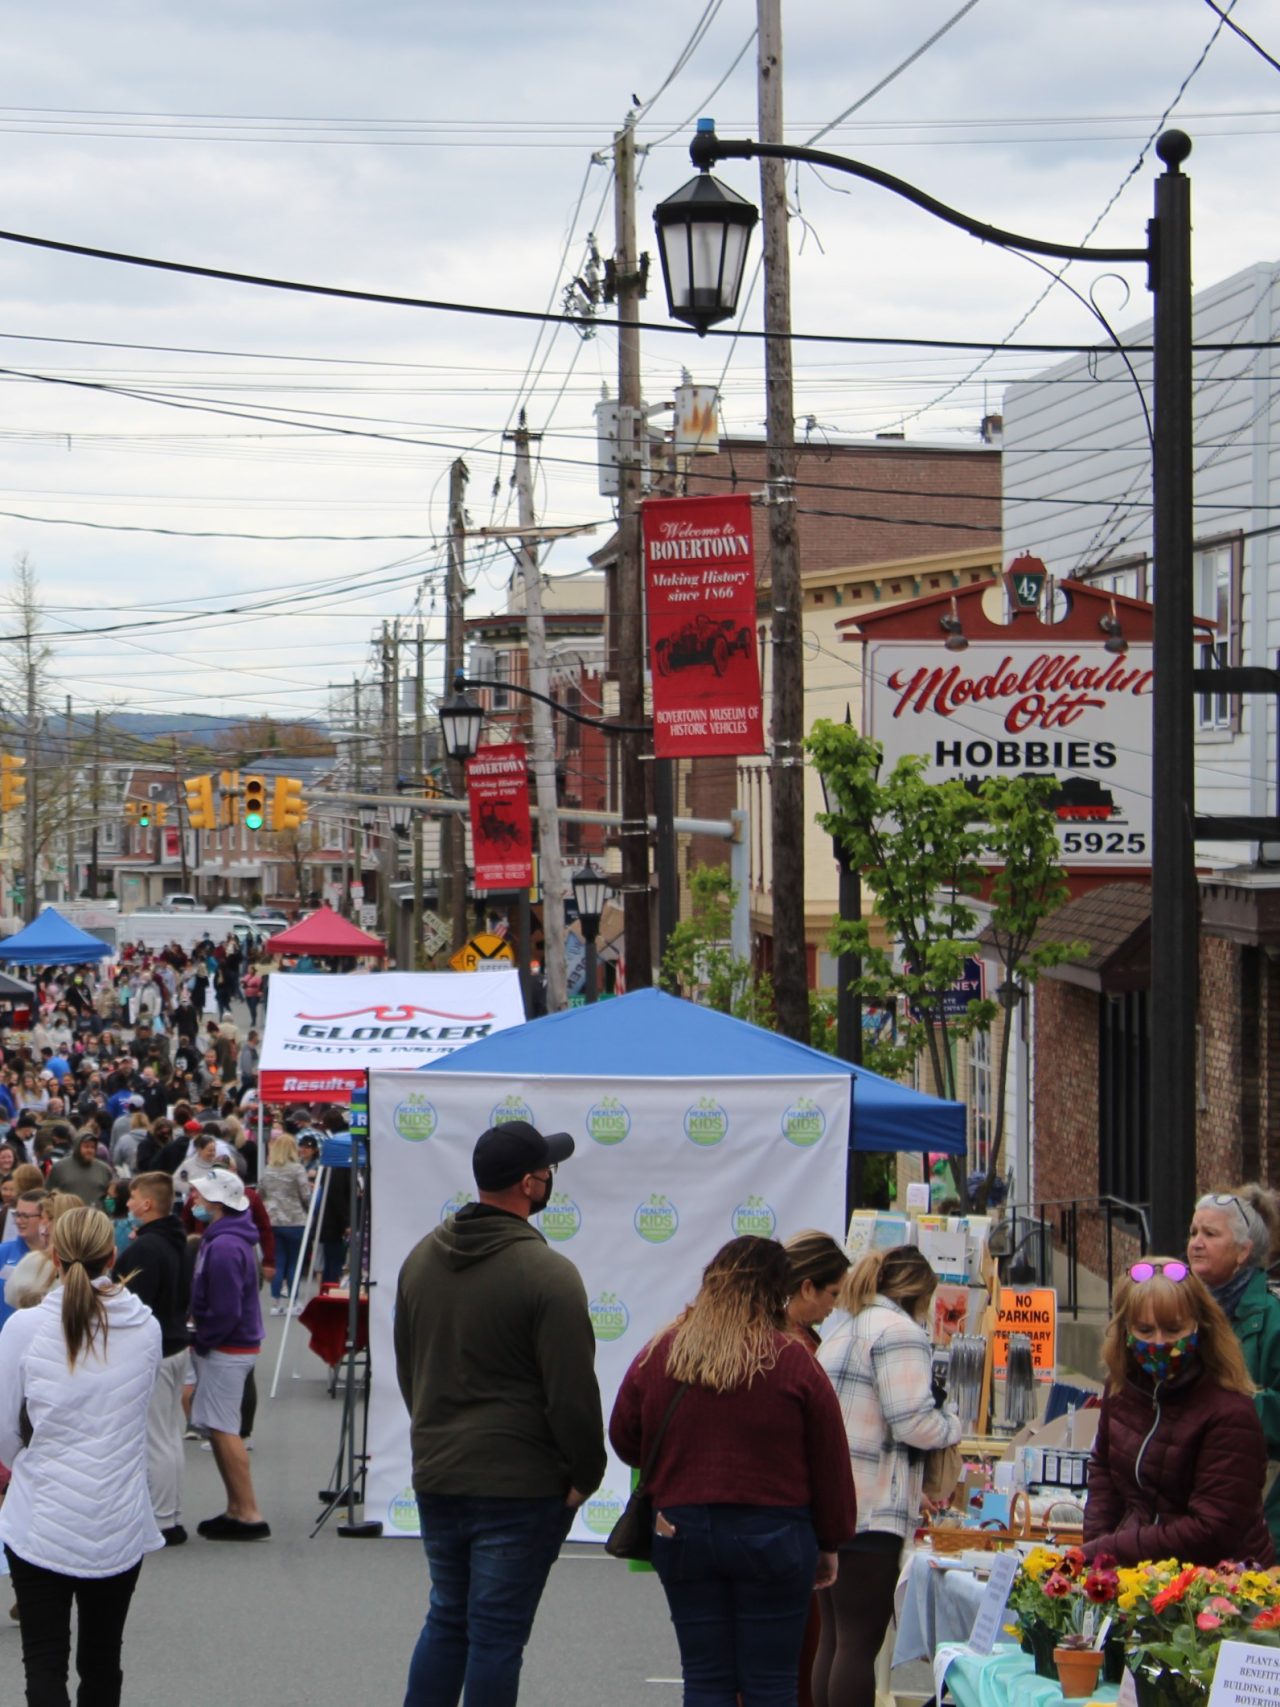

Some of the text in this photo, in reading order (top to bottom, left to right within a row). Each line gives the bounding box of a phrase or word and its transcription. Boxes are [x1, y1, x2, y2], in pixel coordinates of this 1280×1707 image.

[660, 521, 735, 538] Welcome to
[650, 535, 749, 560] BOYERTOWN
[652, 569, 750, 588] Making History
[668, 587, 734, 602] since 1866
[1018, 576, 1037, 602] 42
[887, 654, 1153, 718] Modellbahn
[657, 706, 759, 723] BOYERTOWN MUSEUM OF
[1005, 692, 1106, 735] Ott
[670, 721, 747, 736] HISTORIC VEHICLES
[935, 740, 1117, 768] HOBBIES
[466, 954, 477, 967] R
[298, 1023, 492, 1040] GLOCKER
[284, 1043, 360, 1054] REALTY
[391, 1046, 456, 1054] INSUR
[284, 1077, 356, 1092] Results
[399, 1114, 432, 1126] KIDS
[592, 1117, 625, 1129] KIDS
[689, 1118, 722, 1130] KIDS
[787, 1118, 820, 1130] KIDS
[543, 1213, 575, 1225] KIDS
[639, 1215, 672, 1227] KIDS
[737, 1216, 770, 1228] KIDS
[1016, 1296, 1032, 1307] NO
[998, 1310, 1049, 1323] PARKING
[394, 1507, 418, 1518] KID
[588, 1508, 620, 1519] KIDS
[1240, 1667, 1280, 1680] BENEFITT
[1223, 1680, 1264, 1693] BUILDING
[1266, 1686, 1272, 1695] A
